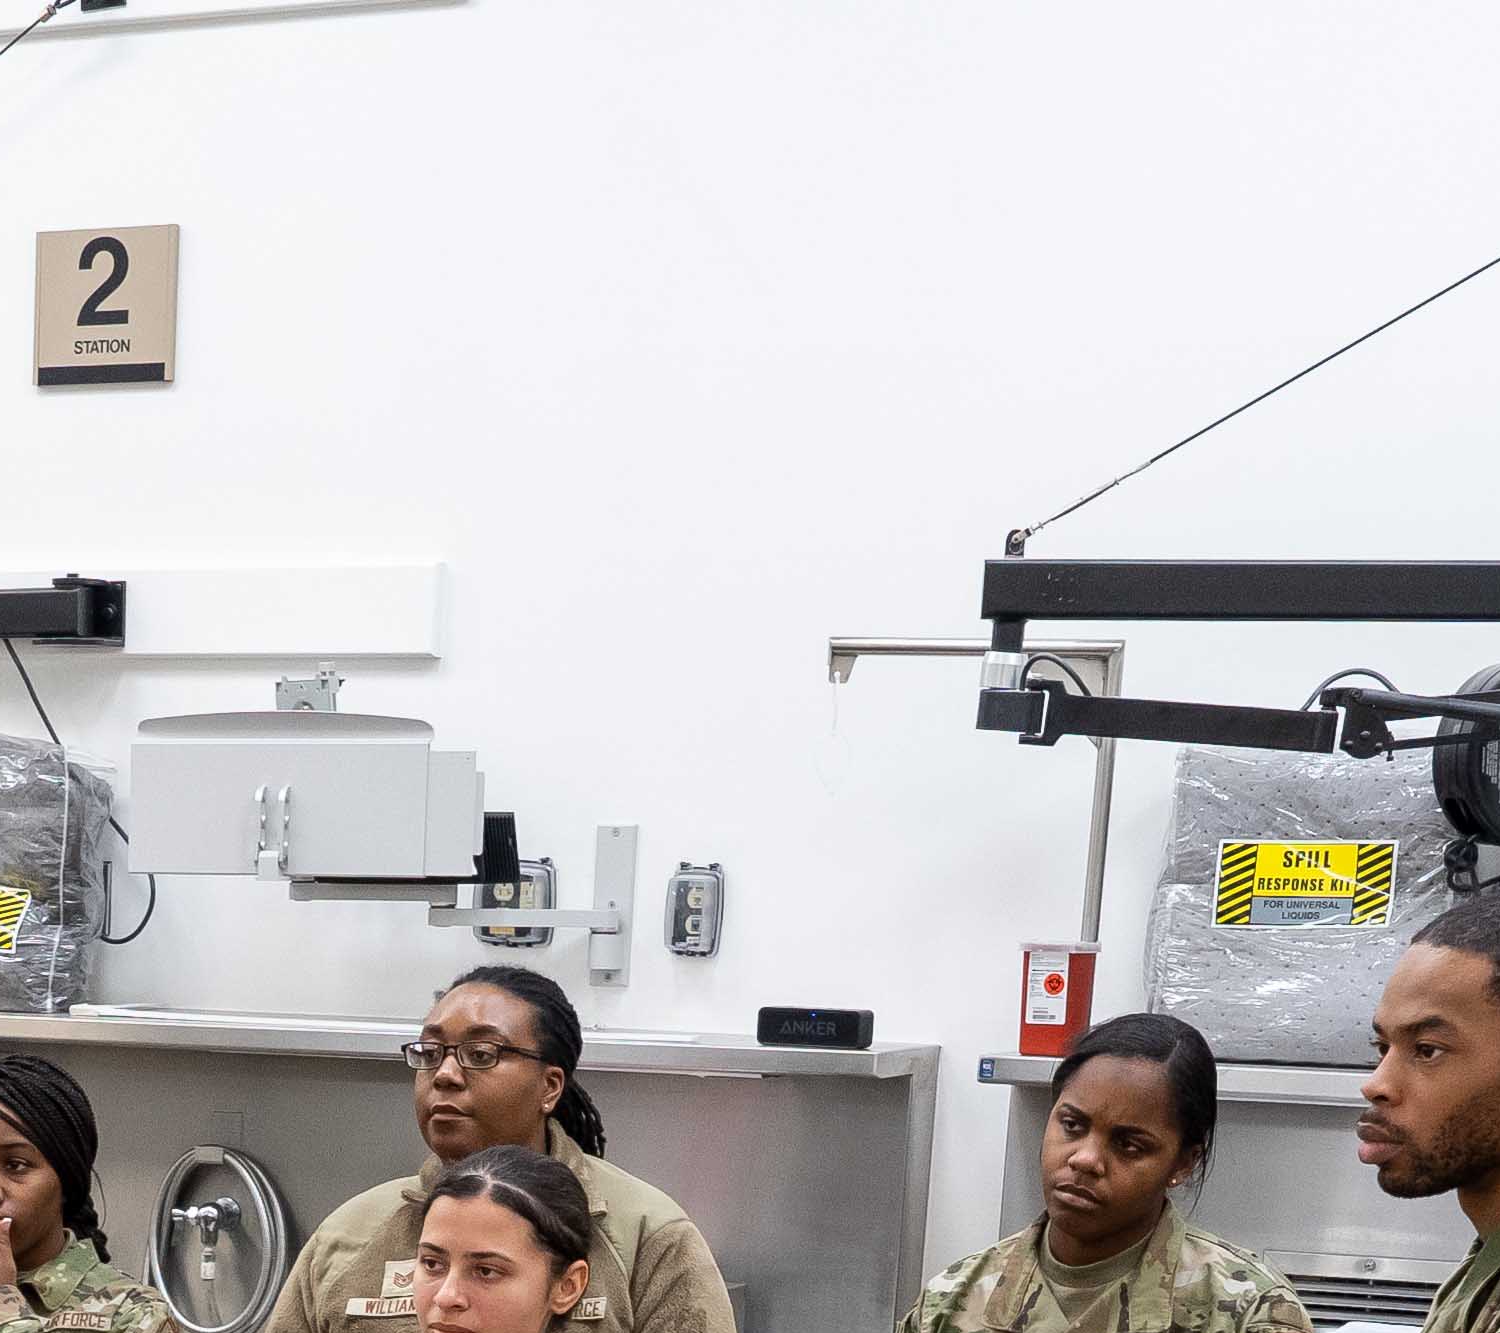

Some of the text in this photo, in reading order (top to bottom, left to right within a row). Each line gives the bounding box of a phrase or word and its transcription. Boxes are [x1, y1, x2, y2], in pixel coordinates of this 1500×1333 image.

[77, 236, 129, 326] 2
[73, 339, 131, 355] STATION
[1283, 850, 1332, 868] SPILL
[1257, 877, 1352, 892] RESPONSE KIT
[1263, 900, 1341, 910] FOR UNIVERSAL
[1281, 911, 1321, 921] LIQUIDS
[779, 1021, 838, 1037] ANKER
[576, 1301, 600, 1316] RCE
[61, 1312, 106, 1328] FORCE
